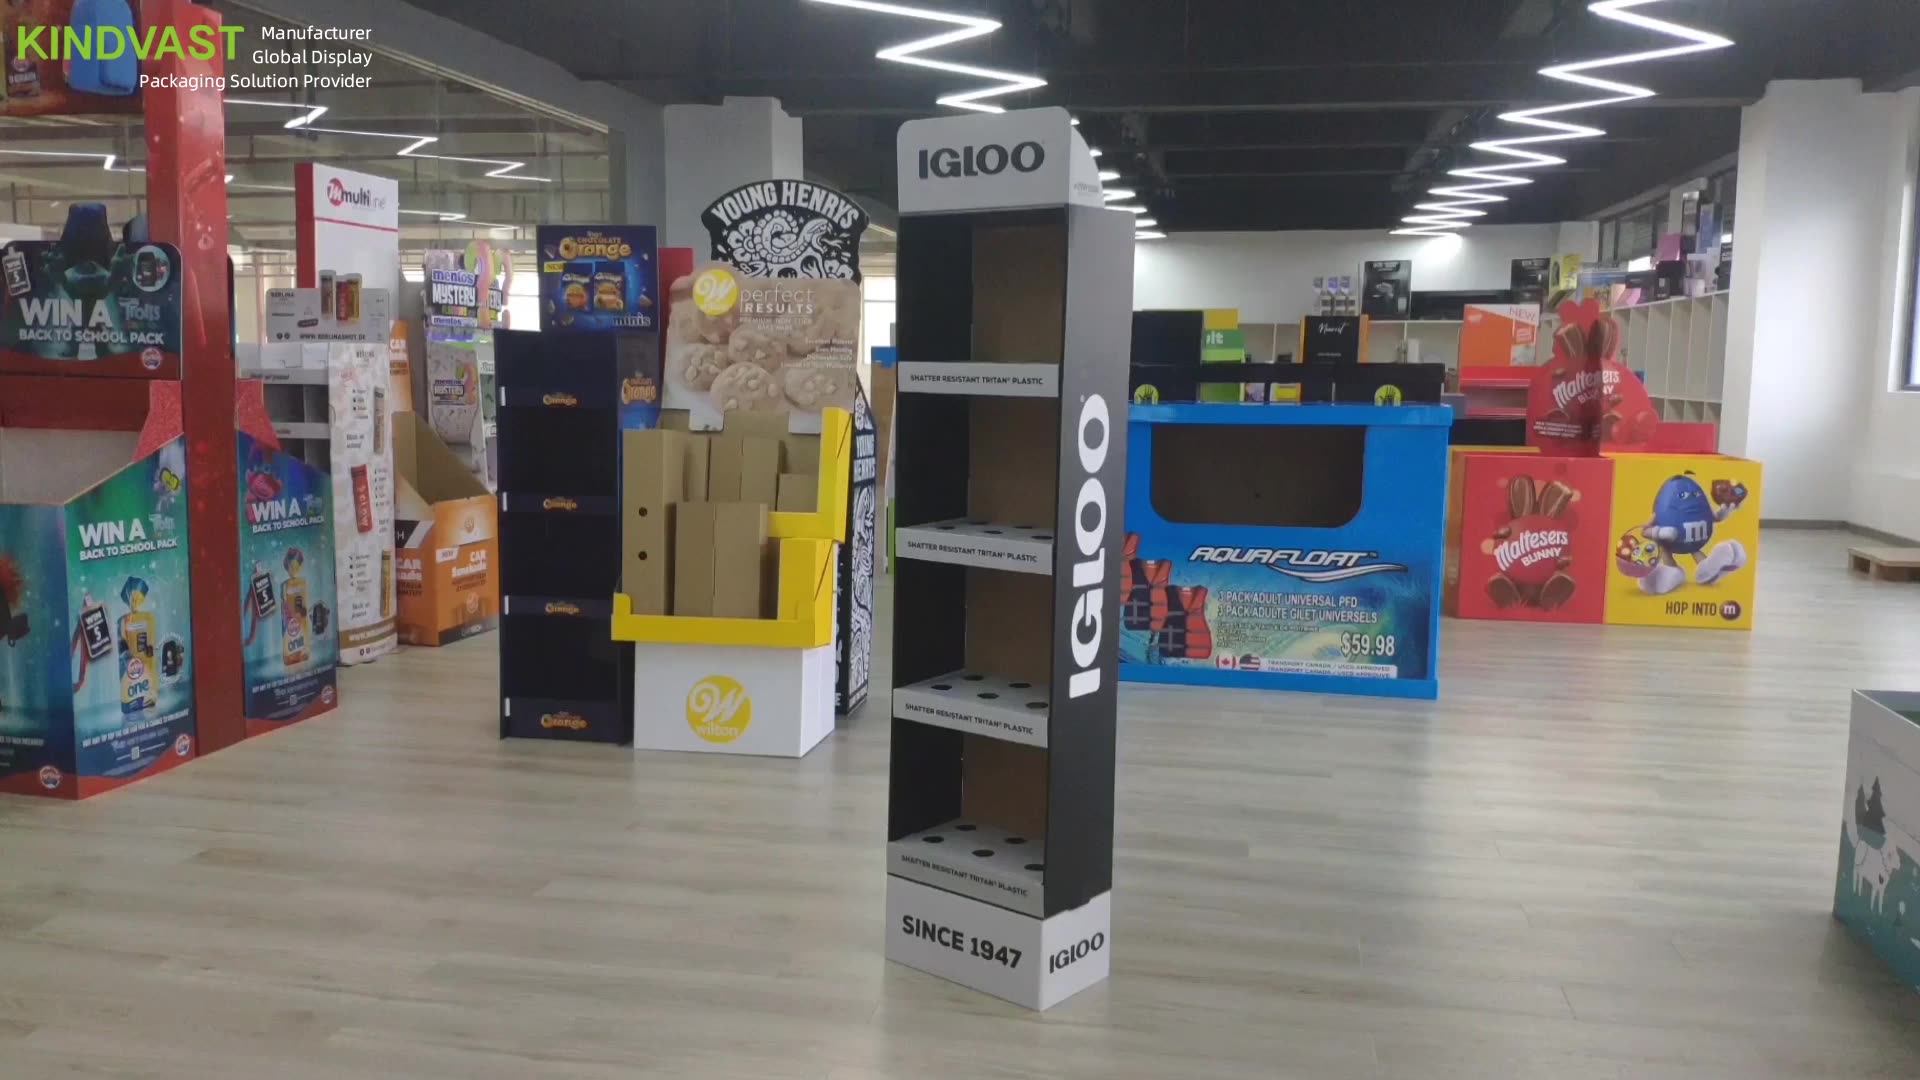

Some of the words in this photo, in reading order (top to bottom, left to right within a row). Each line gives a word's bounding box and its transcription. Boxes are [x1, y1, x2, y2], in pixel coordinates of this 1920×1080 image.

[919, 141, 1045, 179] IGLOO
[711, 182, 777, 226] YOUNG
[781, 181, 859, 229] HENRYS
[559, 237, 632, 261] Orange
[433, 271, 475, 285] mentos
[433, 283, 475, 307] MYSTERY
[740, 282, 814, 309] perfect
[19, 298, 82, 327] WIN
[89, 298, 112, 328] A
[744, 303, 814, 313] RESULTS
[1509, 305, 1536, 321] NEW
[19, 329, 51, 341] BACK
[54, 330, 71, 342] TO
[75, 330, 128, 343] SCHOOL
[130, 331, 164, 345] PACK
[910, 374, 941, 382] SHATTER
[942, 375, 980, 384] RESISTANT
[1012, 377, 1043, 385] PLASTIC
[252, 499, 287, 522] WIN
[288, 497, 301, 518] A
[78, 520, 125, 547] WIN
[129, 518, 146, 541] A
[252, 524, 272, 534] BACK
[273, 522, 282, 530] TO
[283, 518, 308, 529] SCHOOL
[309, 516, 324, 525] PACK
[1683, 521, 1707, 543] m
[79, 549, 105, 560] BACK
[106, 547, 119, 556] TO
[120, 542, 156, 554] SCHOOL
[157, 538, 177, 549] PACK
[470, 549, 487, 562] CAR
[907, 541, 938, 551] SHATTER
[938, 544, 976, 555] RESISTANT
[1007, 552, 1037, 563] PLASTIC
[1069, 393, 1110, 699] IGLOO
[1189, 546, 1368, 567] AQUAFLOAT
[1494, 529, 1569, 572] Maltesers
[1521, 547, 1562, 567] BUNNY
[1218, 591, 1224, 601] 3
[1226, 591, 1250, 602] PACK
[1252, 592, 1282, 604] ADULT
[1285, 594, 1336, 607] UNIVERSAL
[1339, 596, 1358, 608] PFD
[1665, 602, 1688, 615] HOP
[1691, 602, 1717, 616] INTO
[1217, 604, 1224, 616] 3
[1226, 604, 1250, 617] PACK
[1251, 606, 1287, 619] ADULTE
[1289, 608, 1316, 621] GILET
[1318, 610, 1377, 624] UNIVERSELS
[94, 626, 101, 641] 5
[1340, 631, 1395, 657] $59.98
[128, 678, 149, 697] one
[541, 714, 588, 731] Orange
[696, 720, 740, 737] wilton
[905, 703, 935, 715] SHATTER
[936, 709, 973, 723] RESISTANT
[1003, 722, 1033, 735] PLASTIC
[901, 855, 931, 869] SHATTER
[931, 861, 967, 879] RESISTANT
[998, 880, 1028, 898] PLASTIC
[902, 914, 964, 951] SINCE
[970, 937, 1023, 969] 1947
[1049, 932, 1105, 974] IGLOO
